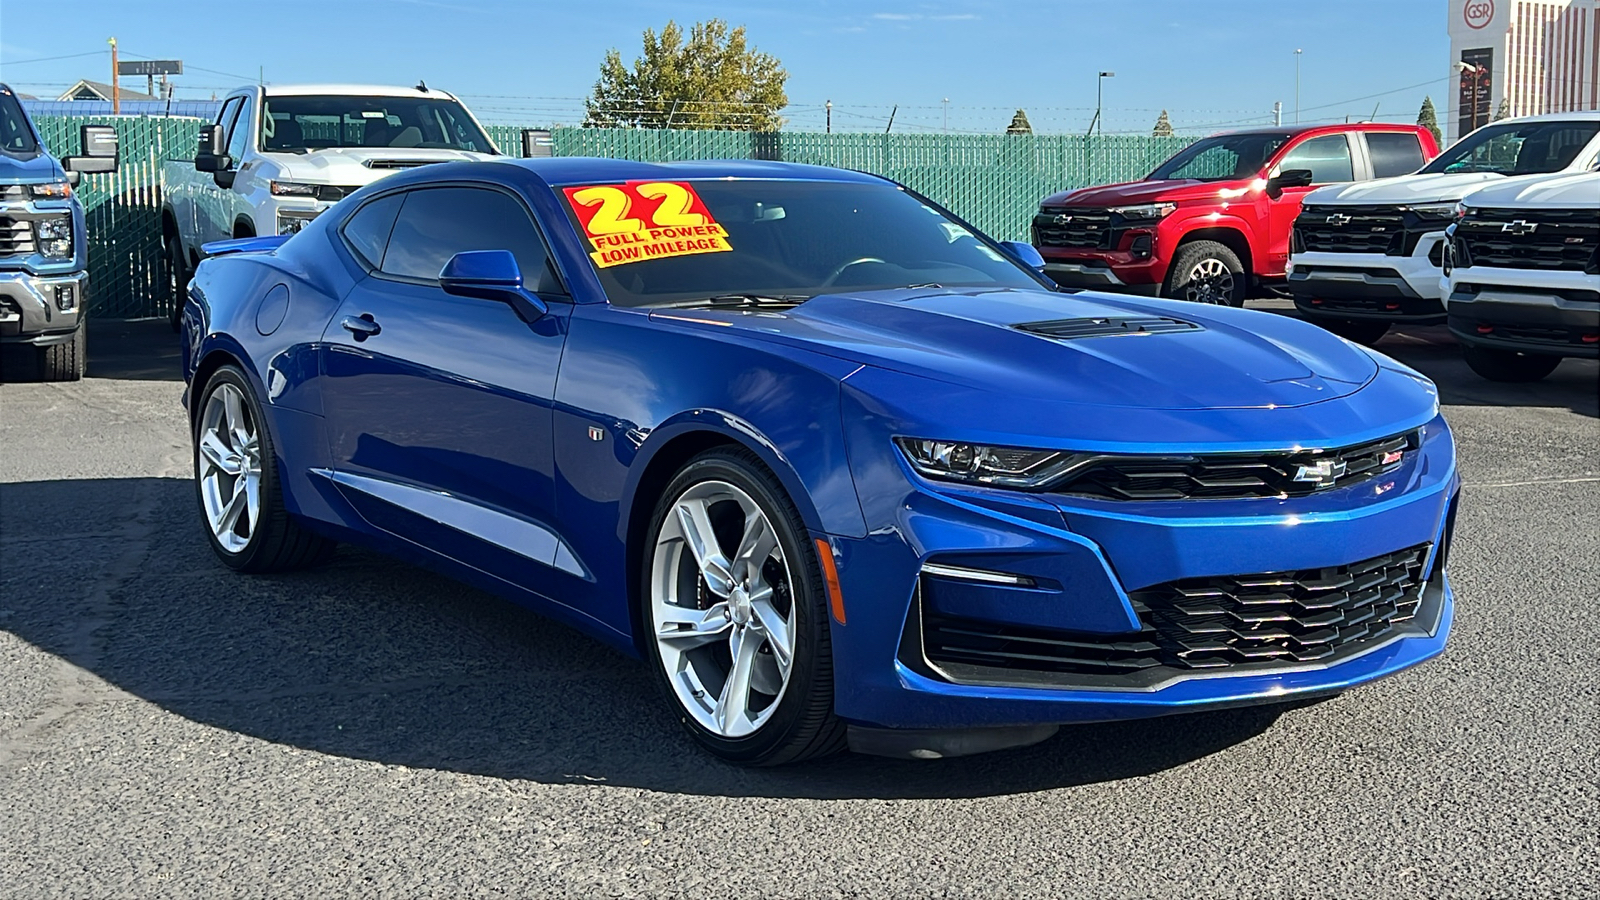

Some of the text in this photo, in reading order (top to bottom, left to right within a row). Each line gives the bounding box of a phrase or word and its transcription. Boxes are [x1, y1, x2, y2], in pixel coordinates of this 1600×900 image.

[1467, 4, 1490, 19] GSR
[572, 183, 708, 235] 22
[594, 225, 720, 249] FULL POWER
[600, 238, 720, 264] LOW MILEAGE
